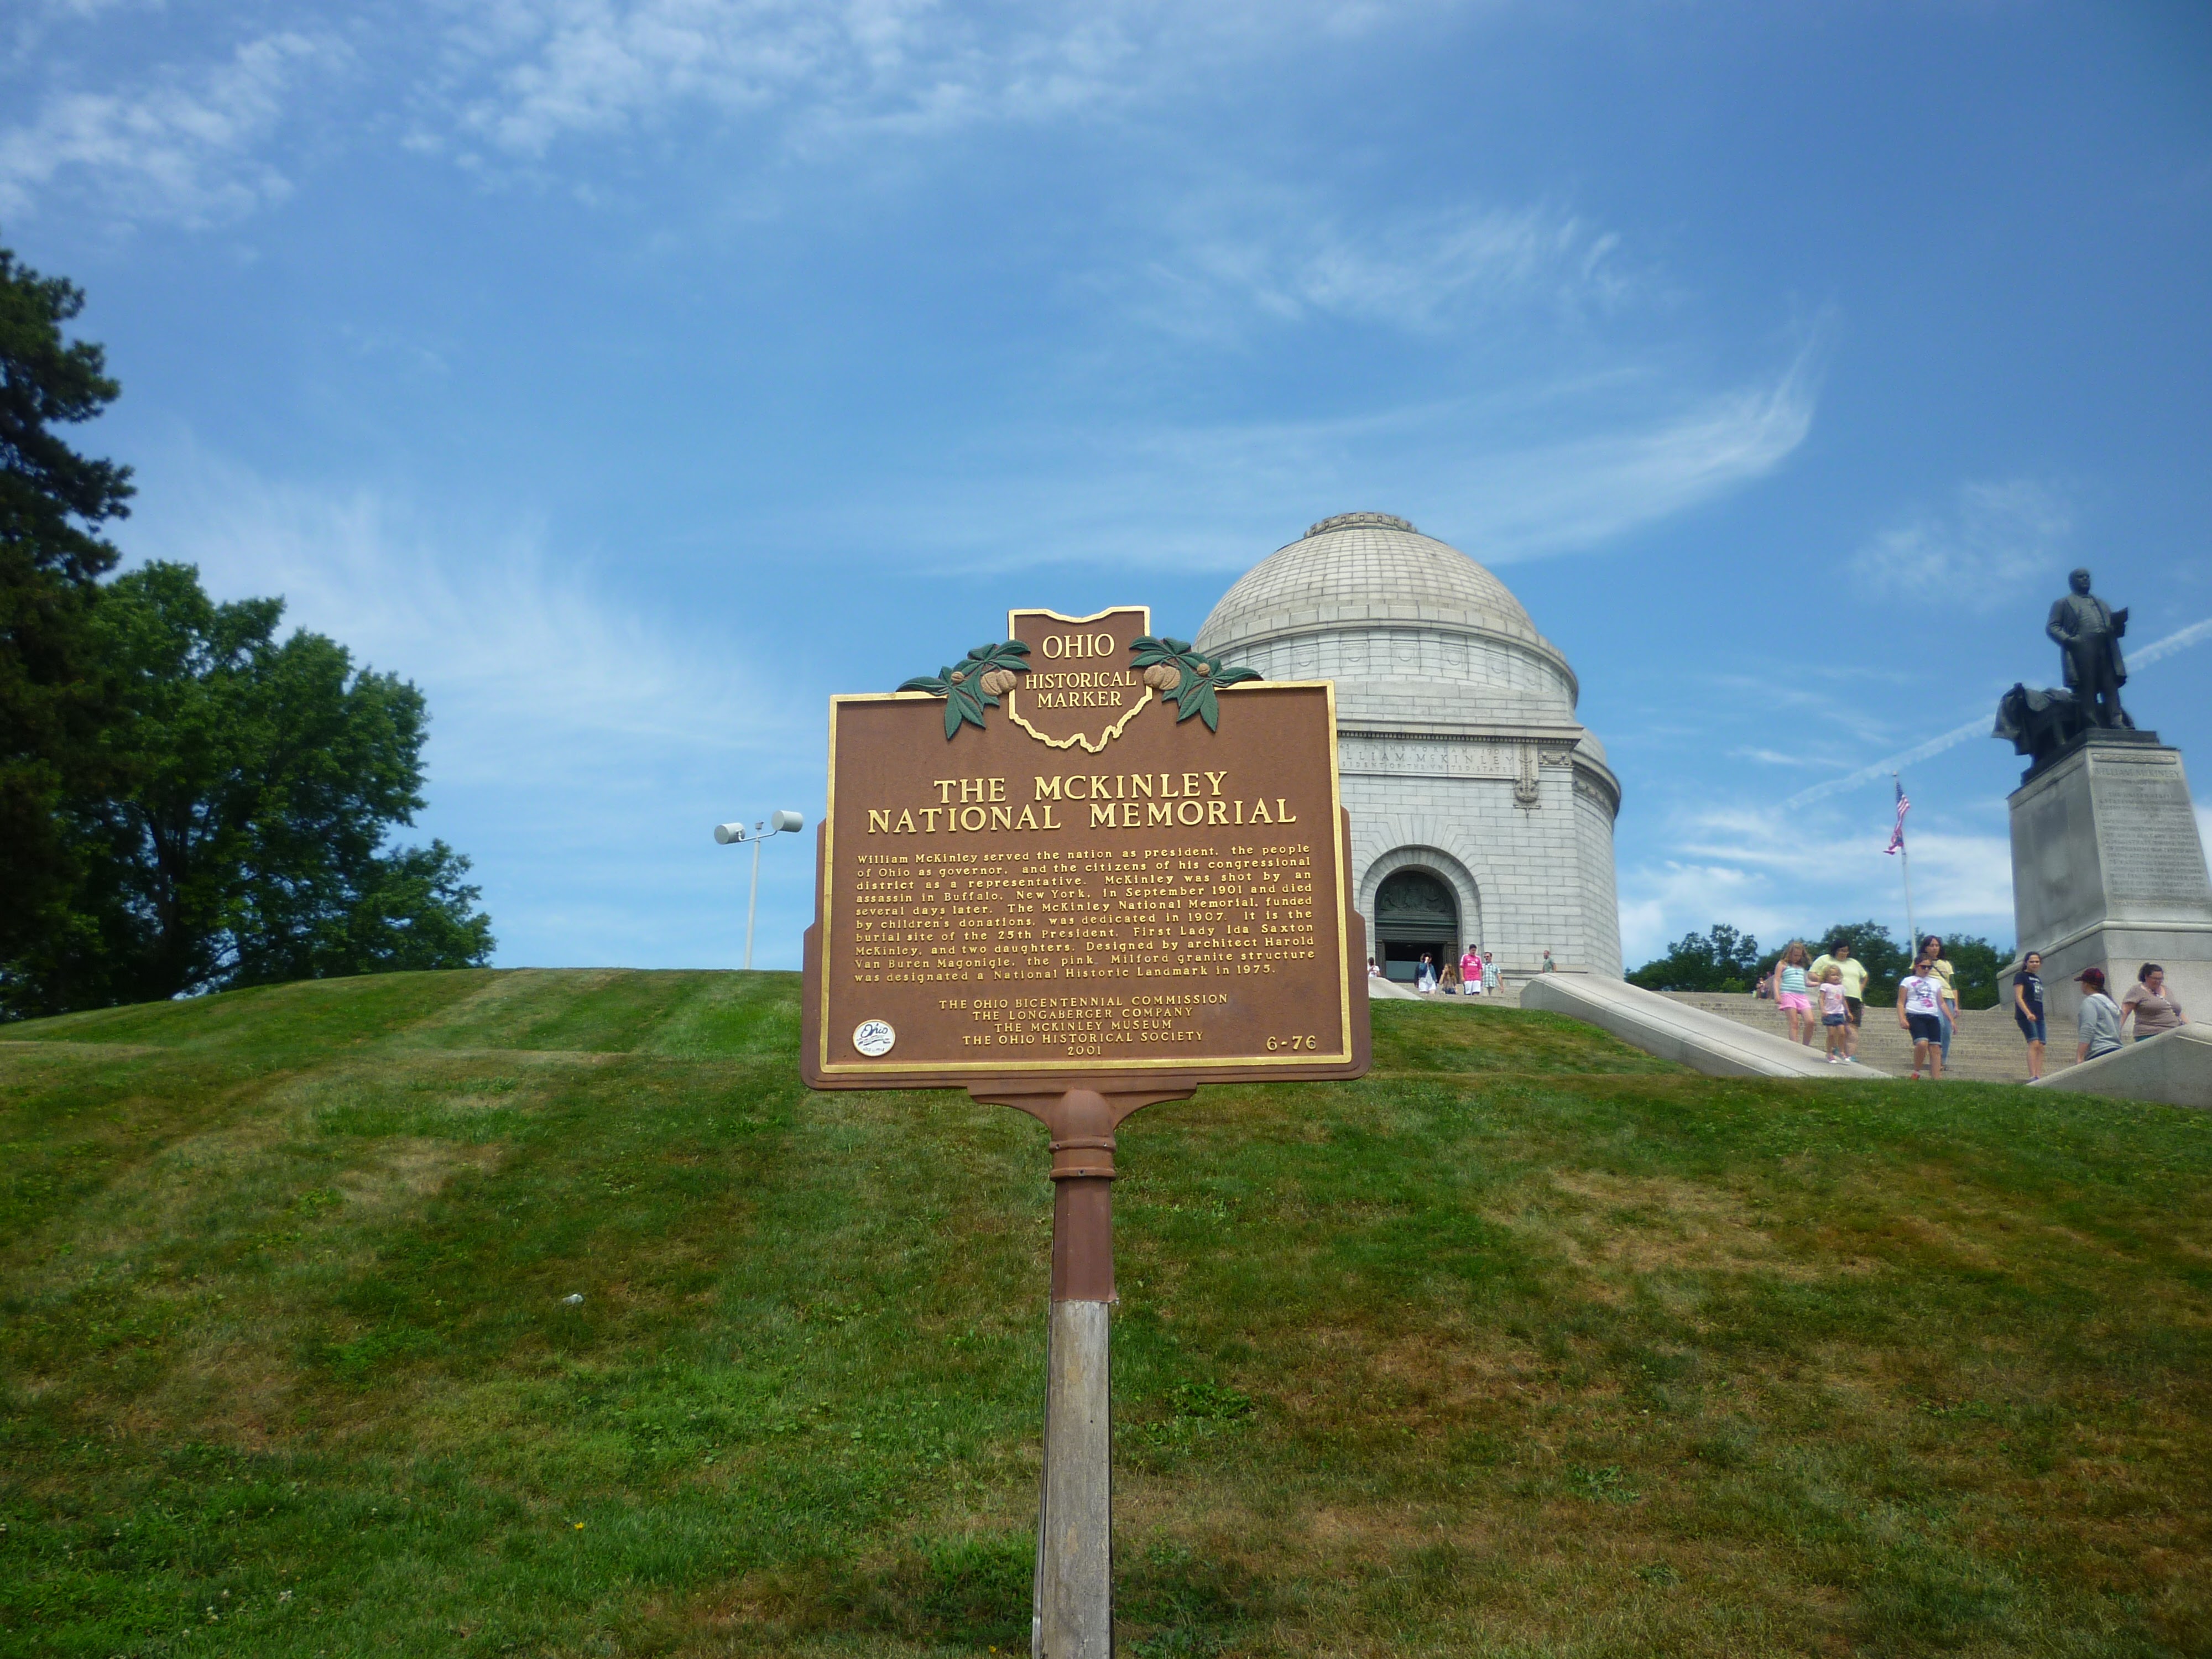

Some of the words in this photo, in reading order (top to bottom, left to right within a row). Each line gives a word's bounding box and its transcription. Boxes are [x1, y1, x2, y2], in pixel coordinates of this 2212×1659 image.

[1042, 633, 1115, 659] OHIO
[1025, 670, 1136, 689] HISTORICAL
[1037, 691, 1123, 708] MARKER
[1346, 751, 1405, 762] LLIAM
[1389, 745, 1468, 753] MEMORIAM
[933, 778, 1006, 804] THE
[1034, 771, 1228, 801] MCKINLEY
[868, 804, 1061, 833] NATIONAL
[1089, 797, 1297, 828] MEMORIAL
[857, 854, 908, 864] William
[915, 853, 978, 863] McKinley
[983, 852, 1029, 861] served
[1036, 851, 1060, 860] the
[1067, 849, 1112, 859] nation
[1231, 846, 1253, 854] the
[1262, 843, 1310, 856] people
[857, 868, 872, 877] of
[879, 868, 910, 877] Ohio
[1022, 864, 1047, 874] and
[1053, 863, 1077, 873] the
[1085, 862, 1146, 872] citizens
[1156, 860, 1170, 870] of
[1178, 860, 1199, 869] his
[1208, 856, 1310, 870] congressional
[856, 880, 914, 890] district
[968, 876, 1087, 889] representative.
[1105, 874, 1174, 884] McKinley
[1221, 872, 1251, 881] shot
[1263, 871, 1281, 882] by
[856, 893, 912, 903] assassin
[922, 893, 934, 902] in
[1016, 890, 1045, 900] New
[1103, 888, 1117, 898] in
[1125, 886, 1204, 898] September
[1212, 885, 1242, 895] 1901
[1250, 884, 1276, 894] and
[1282, 883, 1312, 893] died
[855, 906, 904, 916] several
[912, 906, 945, 916] days
[952, 905, 993, 914] later.
[1007, 903, 1034, 913] The
[1042, 901, 1110, 912] McKinley
[1118, 899, 1181, 910] National
[1266, 896, 1312, 906] funded
[856, 920, 873, 931] by
[880, 916, 950, 928] children's
[1082, 914, 1156, 924] dedicated
[1166, 912, 1179, 922] in
[1188, 912, 1227, 922] 1907.
[1244, 911, 1255, 920] It
[1266, 910, 1278, 920] is
[1287, 909, 1312, 919] the
[855, 932, 900, 942] burial
[907, 932, 933, 941] site
[941, 931, 955, 941] of
[964, 931, 987, 940] the
[998, 930, 1031, 940] 25th
[1133, 926, 1171, 936] First
[1180, 926, 1215, 936] Lady
[1227, 924, 1249, 934] Ida
[1261, 924, 1313, 933] Saxton
[931, 946, 955, 954] and
[962, 945, 987, 954] two
[994, 943, 1075, 954] daughters.
[1086, 940, 1154, 952] Designed
[1162, 940, 1178, 951] by
[1187, 938, 1257, 948] architect
[1264, 936, 1314, 947] Harold
[854, 959, 880, 968] Van
[888, 959, 930, 968] Buren
[1027, 956, 1050, 966] the
[1110, 953, 1168, 963] Milford
[1177, 952, 1233, 964] granite
[1241, 951, 1314, 961] structure
[886, 971, 968, 983] designated
[994, 969, 1057, 979] National
[1066, 967, 1129, 978] Historic
[1137, 966, 1208, 976] Landmark
[1216, 966, 1229, 974] in
[1237, 964, 1275, 974] 1975.
[938, 999, 967, 1009] THE
[973, 999, 1008, 1009] OHIO
[1015, 997, 1123, 1008] BICENTENNIAL
[1131, 993, 1227, 1005] COMMISSION
[972, 1011, 999, 1020] THE
[1009, 1009, 1112, 1020] LONGABERGER
[1121, 1007, 1192, 1018] COMPANY
[994, 1022, 1022, 1032] THE
[1031, 1021, 1103, 1031] MCKINLEY
[1111, 1019, 1172, 1030] MUSEUM
[962, 1035, 991, 1045] THE
[998, 1035, 1035, 1044] OHIO
[1042, 1032, 1133, 1044] HISTORICAL
[1140, 1031, 1203, 1041] SOCIETY
[1266, 1035, 1316, 1050] 6-76
[1067, 1045, 1101, 1055] 2001
